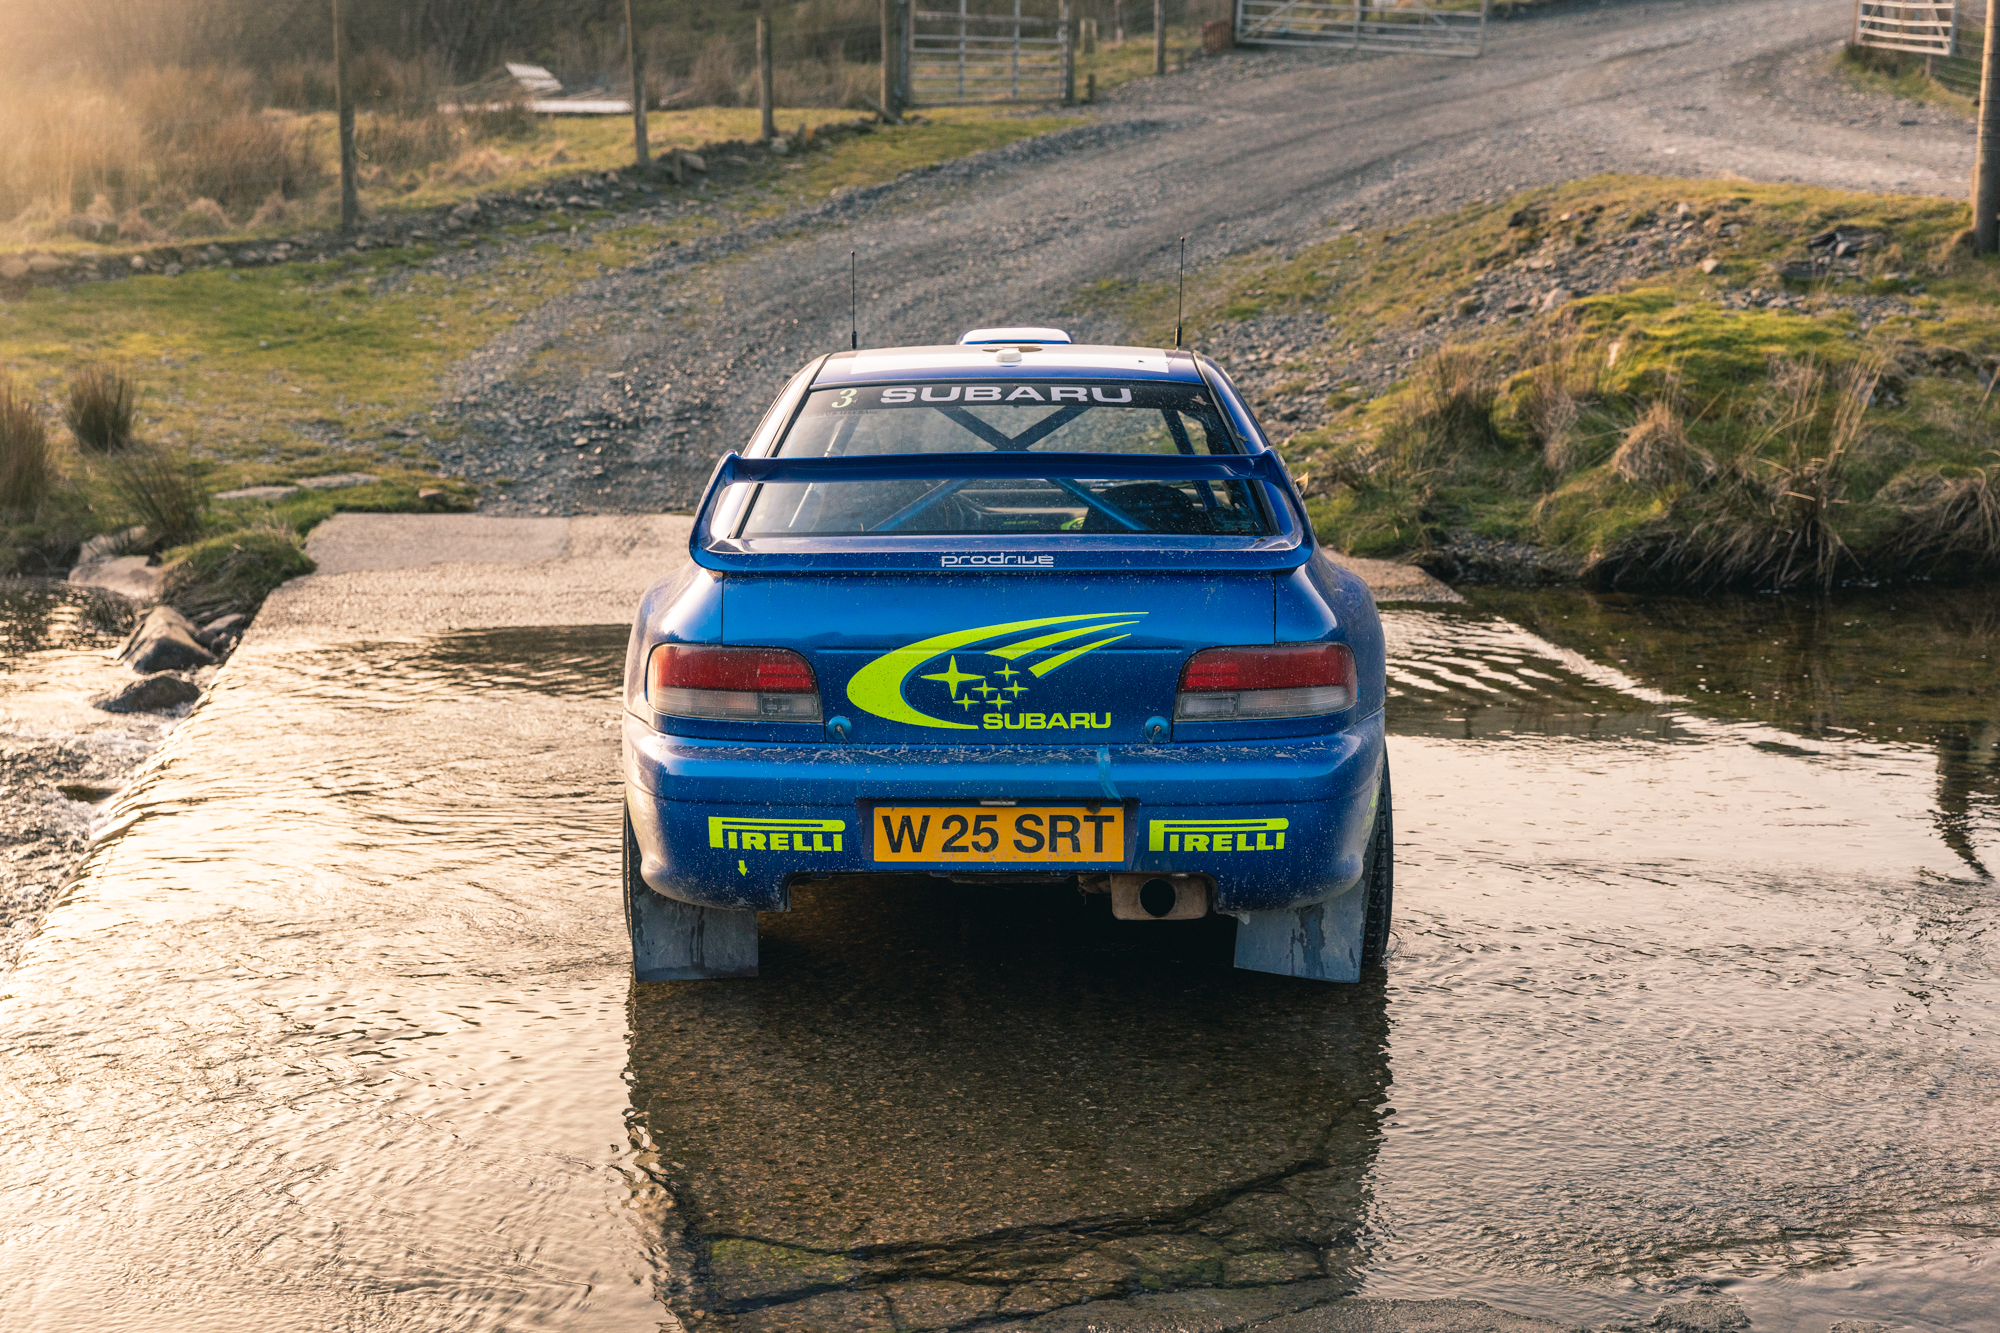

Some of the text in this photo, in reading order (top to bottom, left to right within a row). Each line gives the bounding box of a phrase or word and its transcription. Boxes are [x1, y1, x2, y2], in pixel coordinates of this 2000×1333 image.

[831, 388, 857, 409] 3
[880, 386, 1132, 404] SUBARU
[941, 552, 1054, 568] prodrive
[983, 712, 1111, 730] SUBARU
[708, 816, 846, 852] PIRELLI
[882, 813, 1115, 853] W 25 SRT
[1149, 818, 1289, 852] PIRELLI
